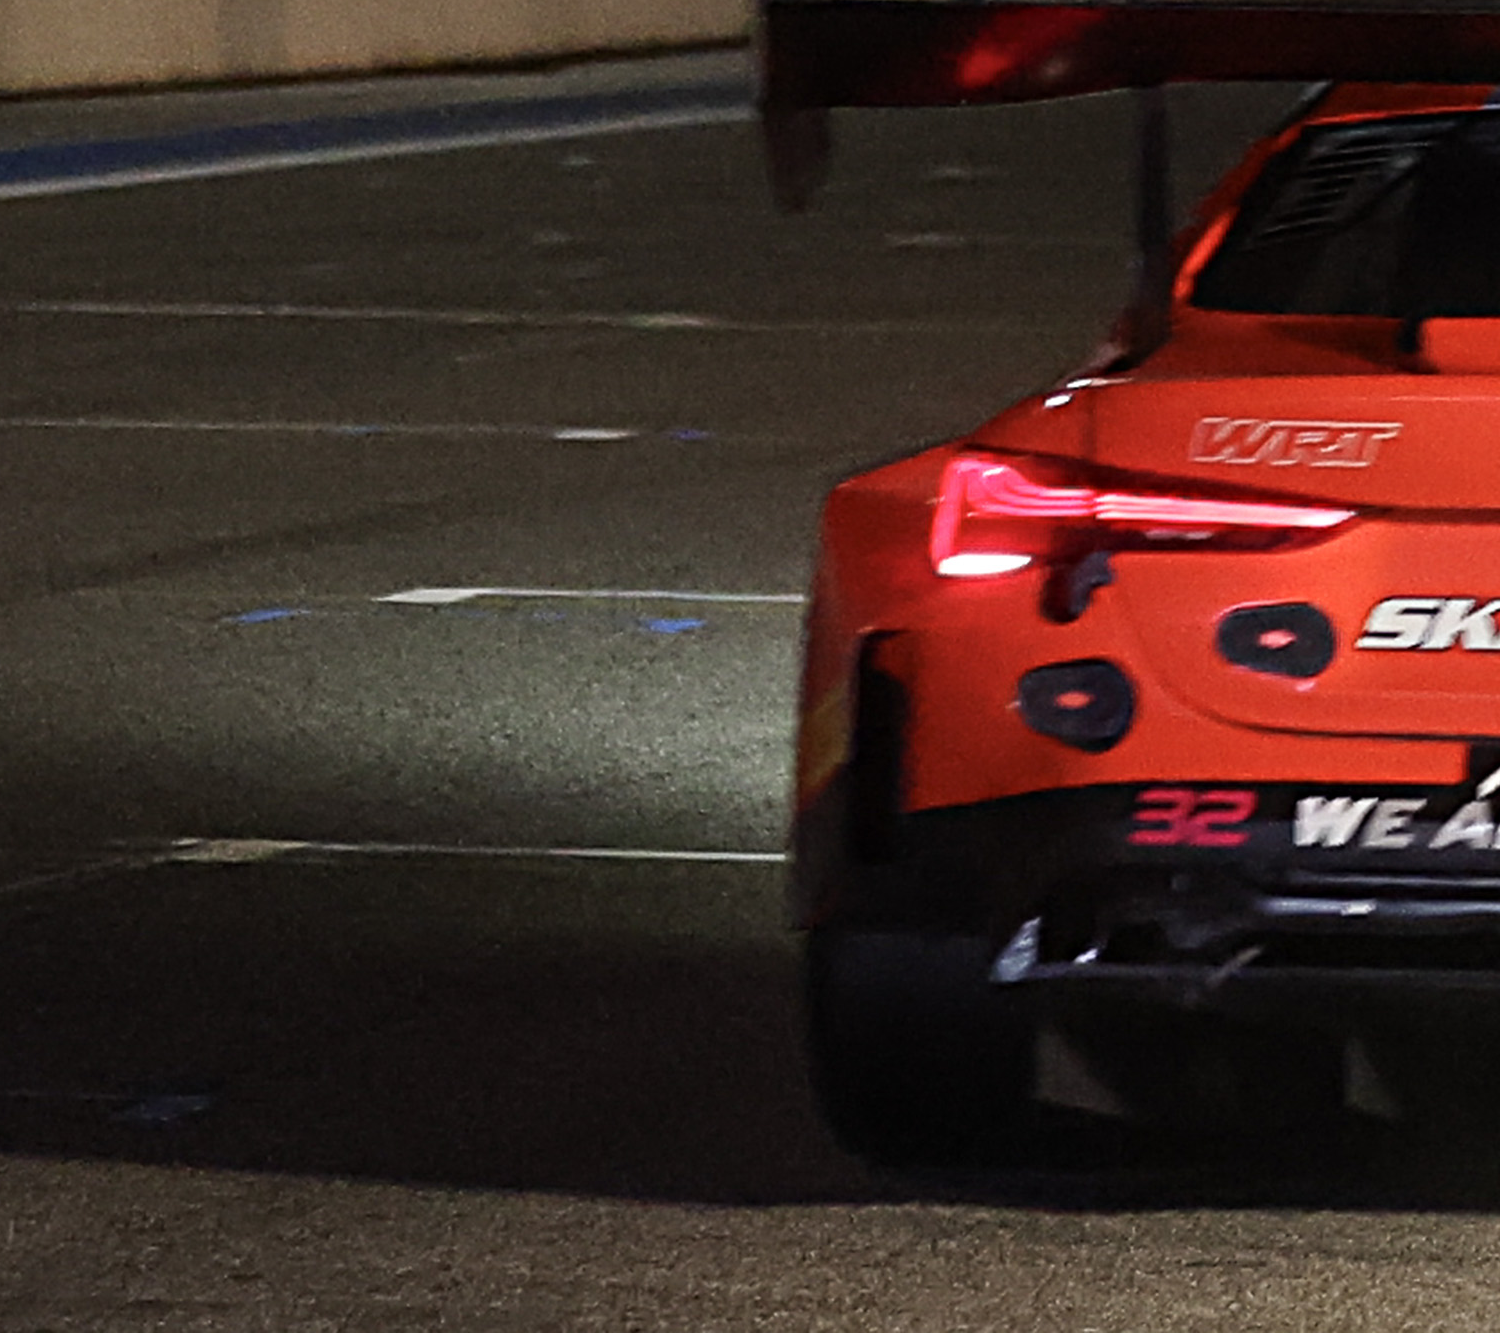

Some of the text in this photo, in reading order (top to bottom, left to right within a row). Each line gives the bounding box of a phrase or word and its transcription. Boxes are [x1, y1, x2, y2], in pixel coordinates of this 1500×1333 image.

[1188, 416, 1403, 468] WRT
[1127, 788, 1258, 847] 32
[1293, 796, 1427, 848] WE
